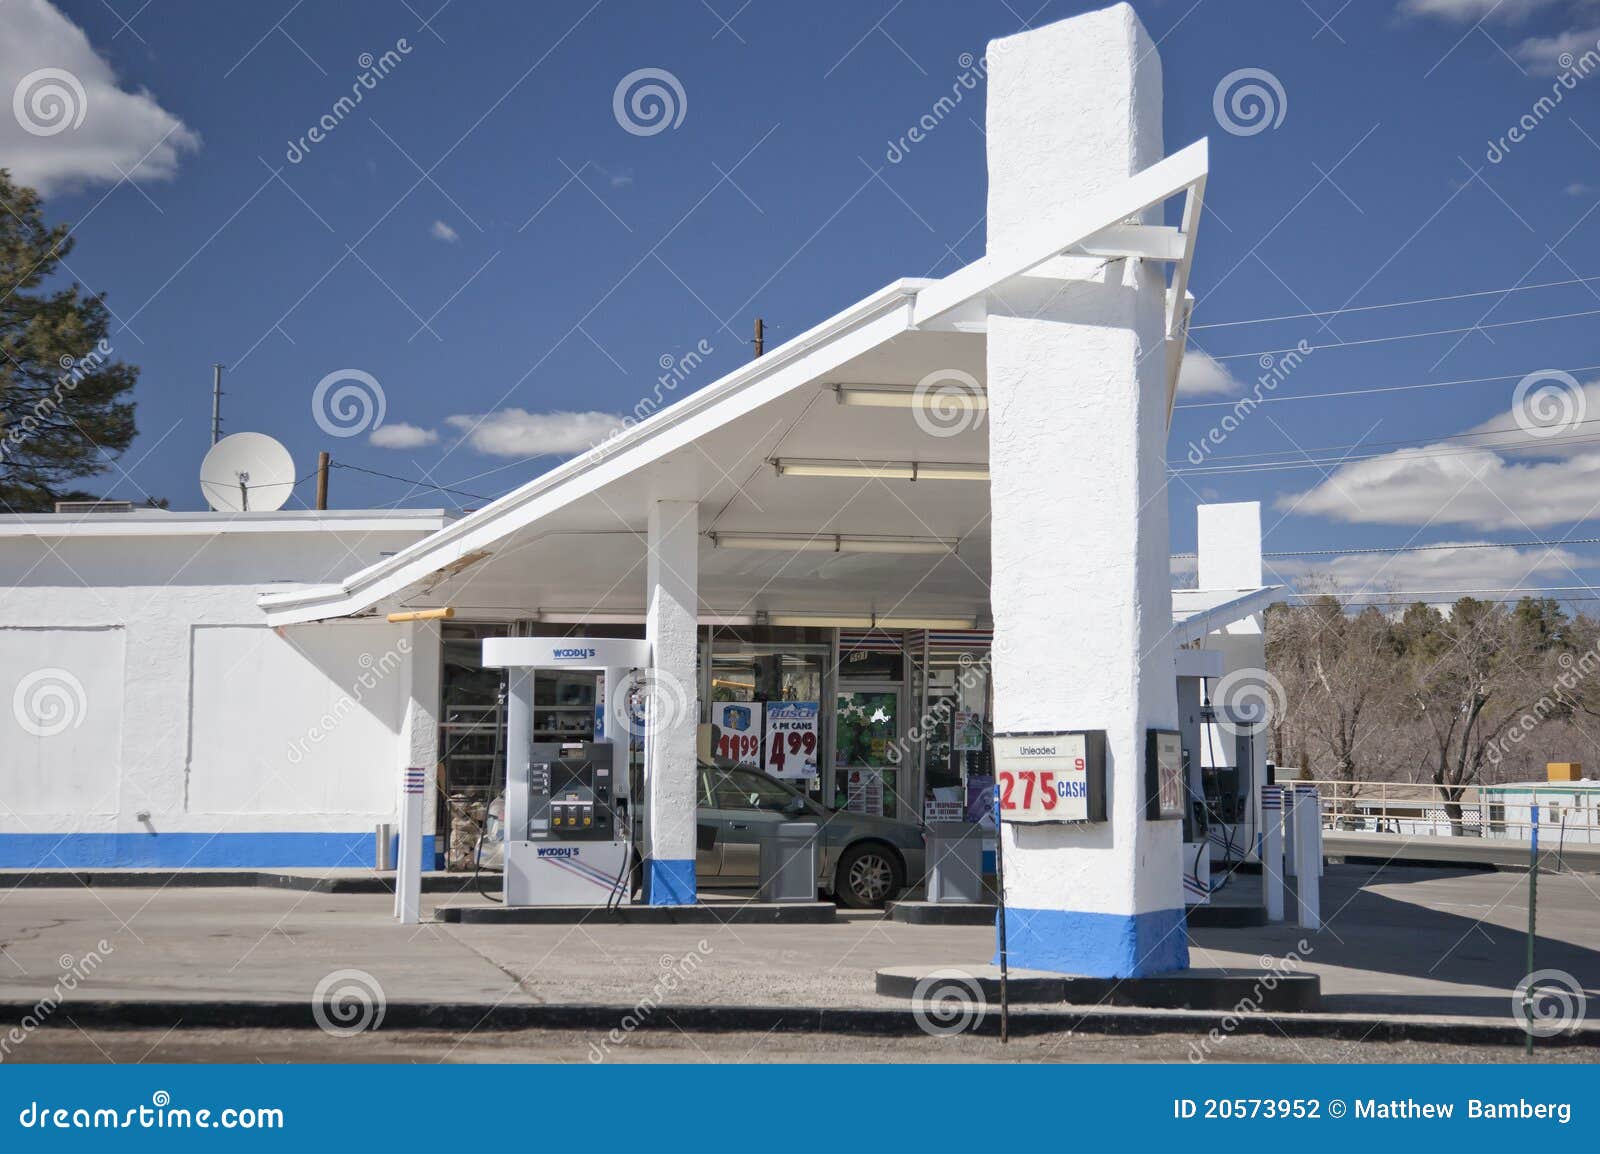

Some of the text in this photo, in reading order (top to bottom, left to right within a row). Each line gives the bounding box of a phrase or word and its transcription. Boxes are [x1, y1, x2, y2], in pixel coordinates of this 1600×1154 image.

[1019, 746, 1056, 755] Unleaded
[1074, 758, 1085, 771] 9
[1000, 771, 1087, 811] 275 CASH
